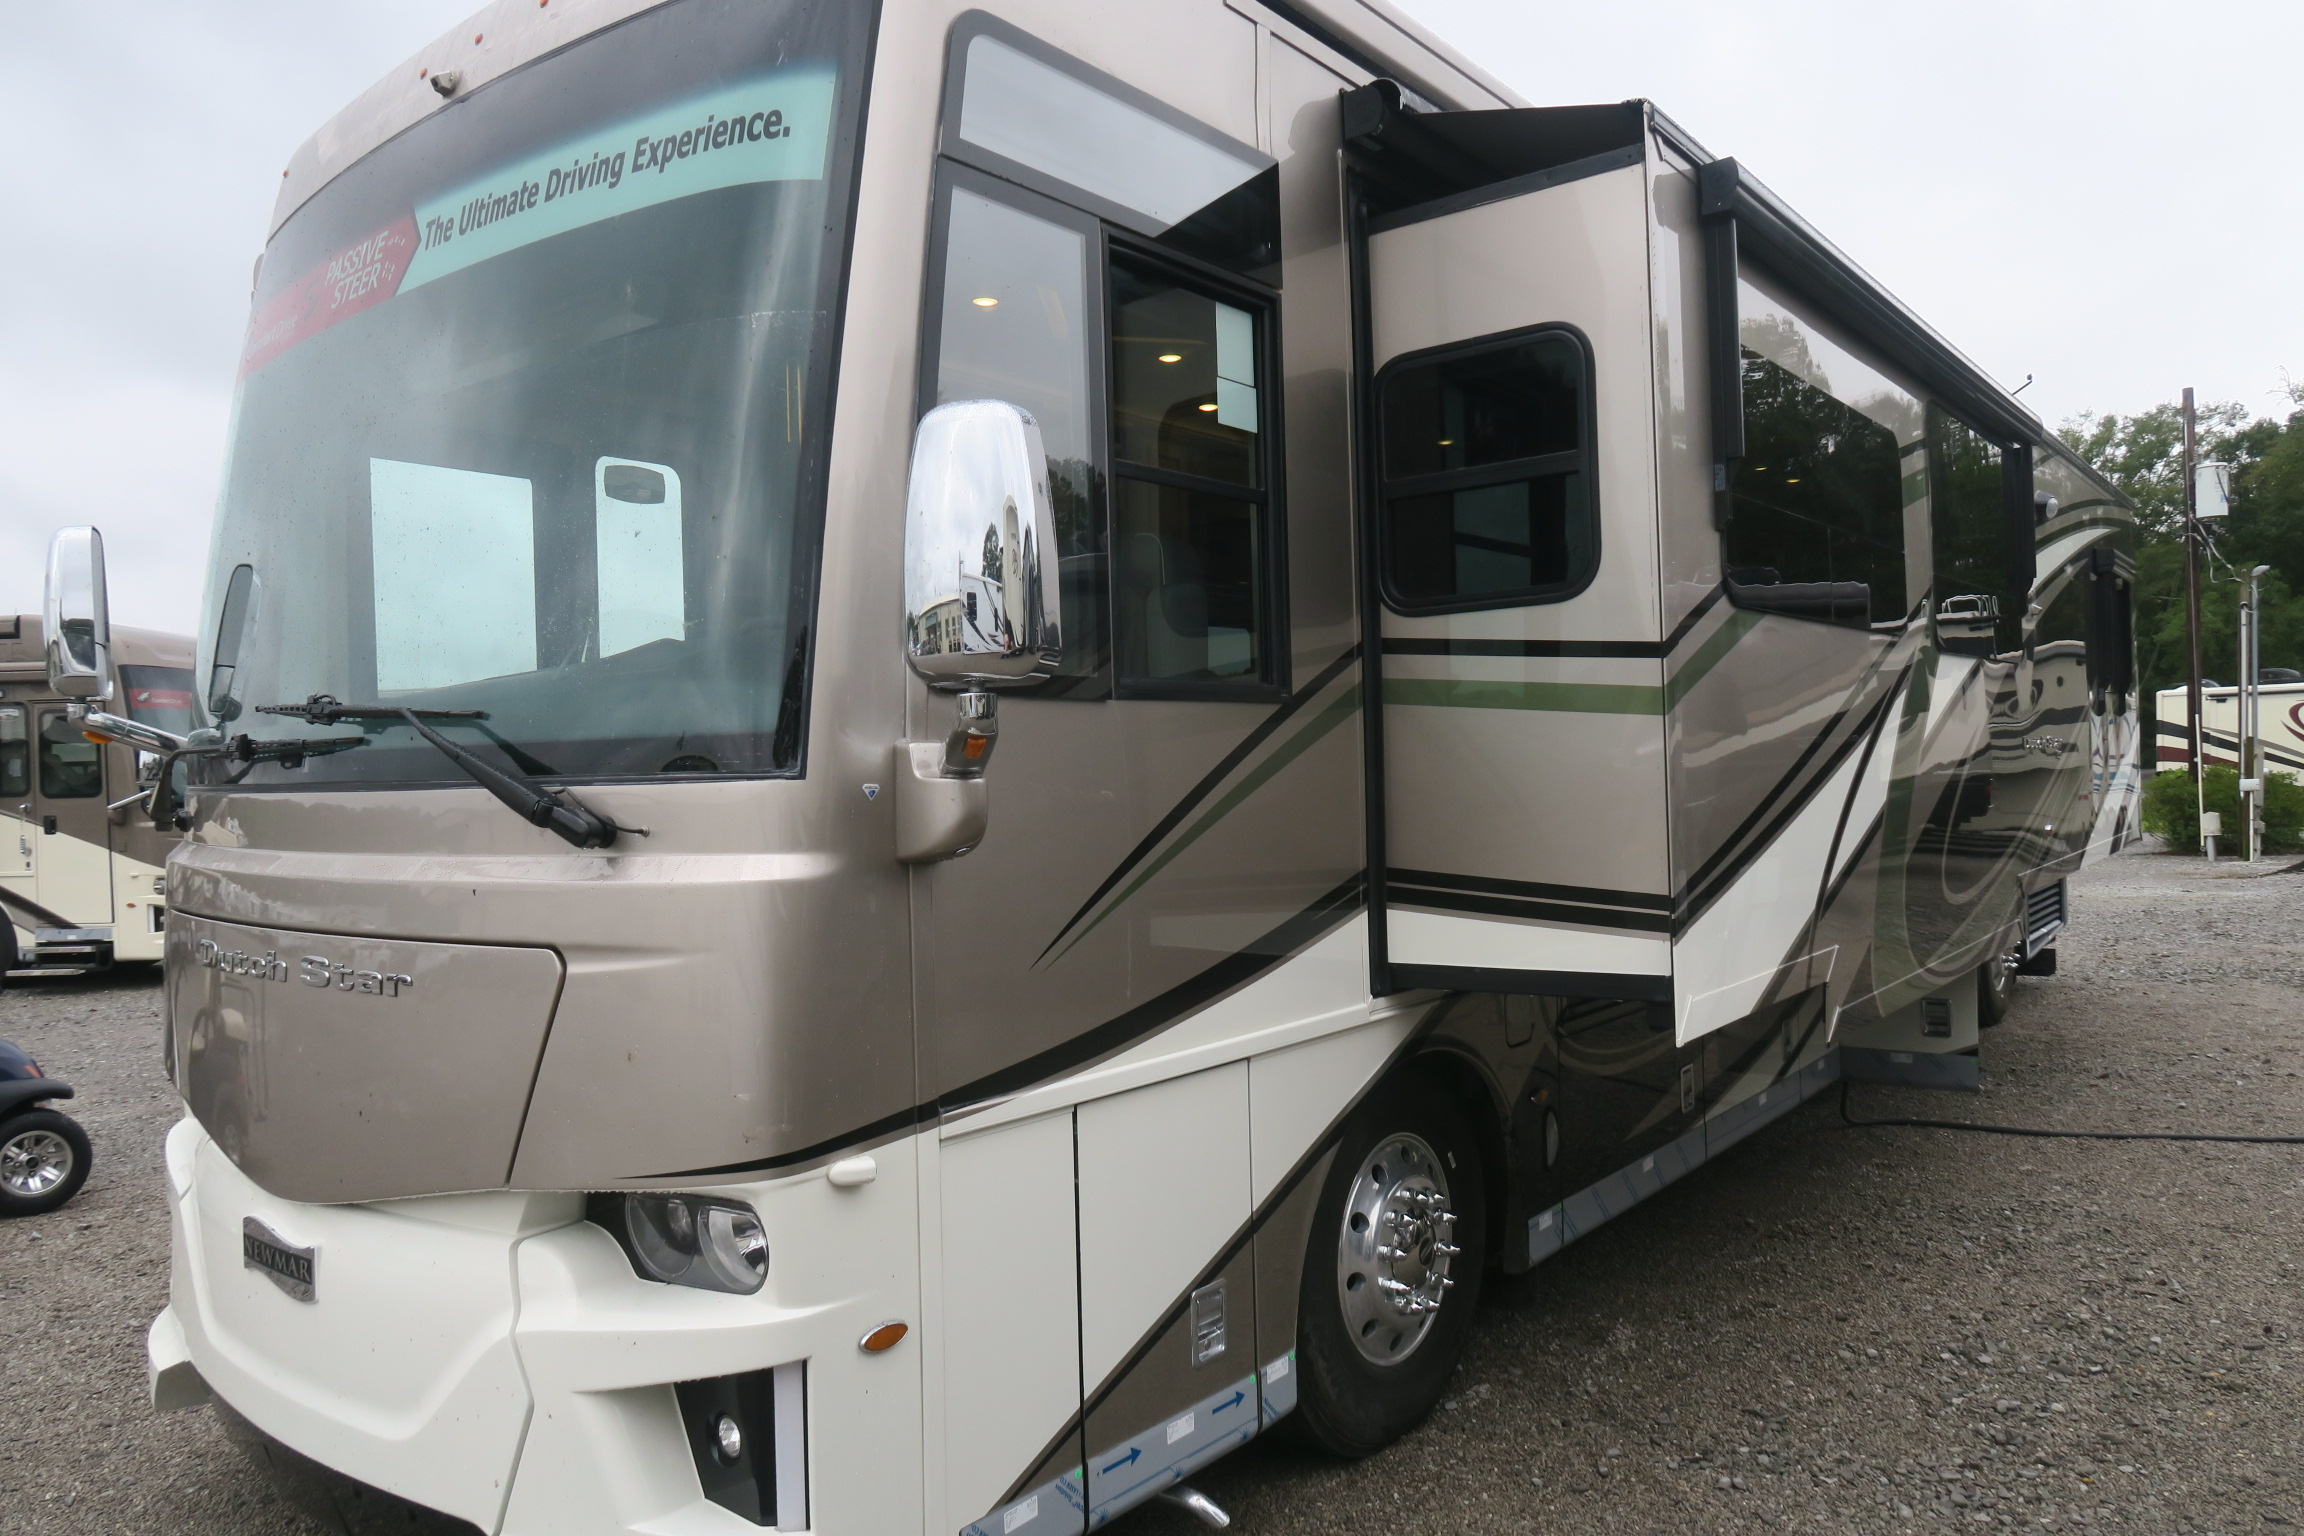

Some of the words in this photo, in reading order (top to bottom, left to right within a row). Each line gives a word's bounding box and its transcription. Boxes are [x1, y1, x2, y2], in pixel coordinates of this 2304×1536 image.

[425, 215, 454, 251] The
[458, 181, 539, 236] Ultimate
[544, 152, 626, 204] Driving
[631, 109, 791, 174] Experience.
[325, 230, 389, 287] PASSIVE
[331, 262, 382, 309] STEER
[200, 939, 288, 982] Dutch
[300, 955, 414, 998] Star
[243, 1235, 312, 1282] NEWMAR
